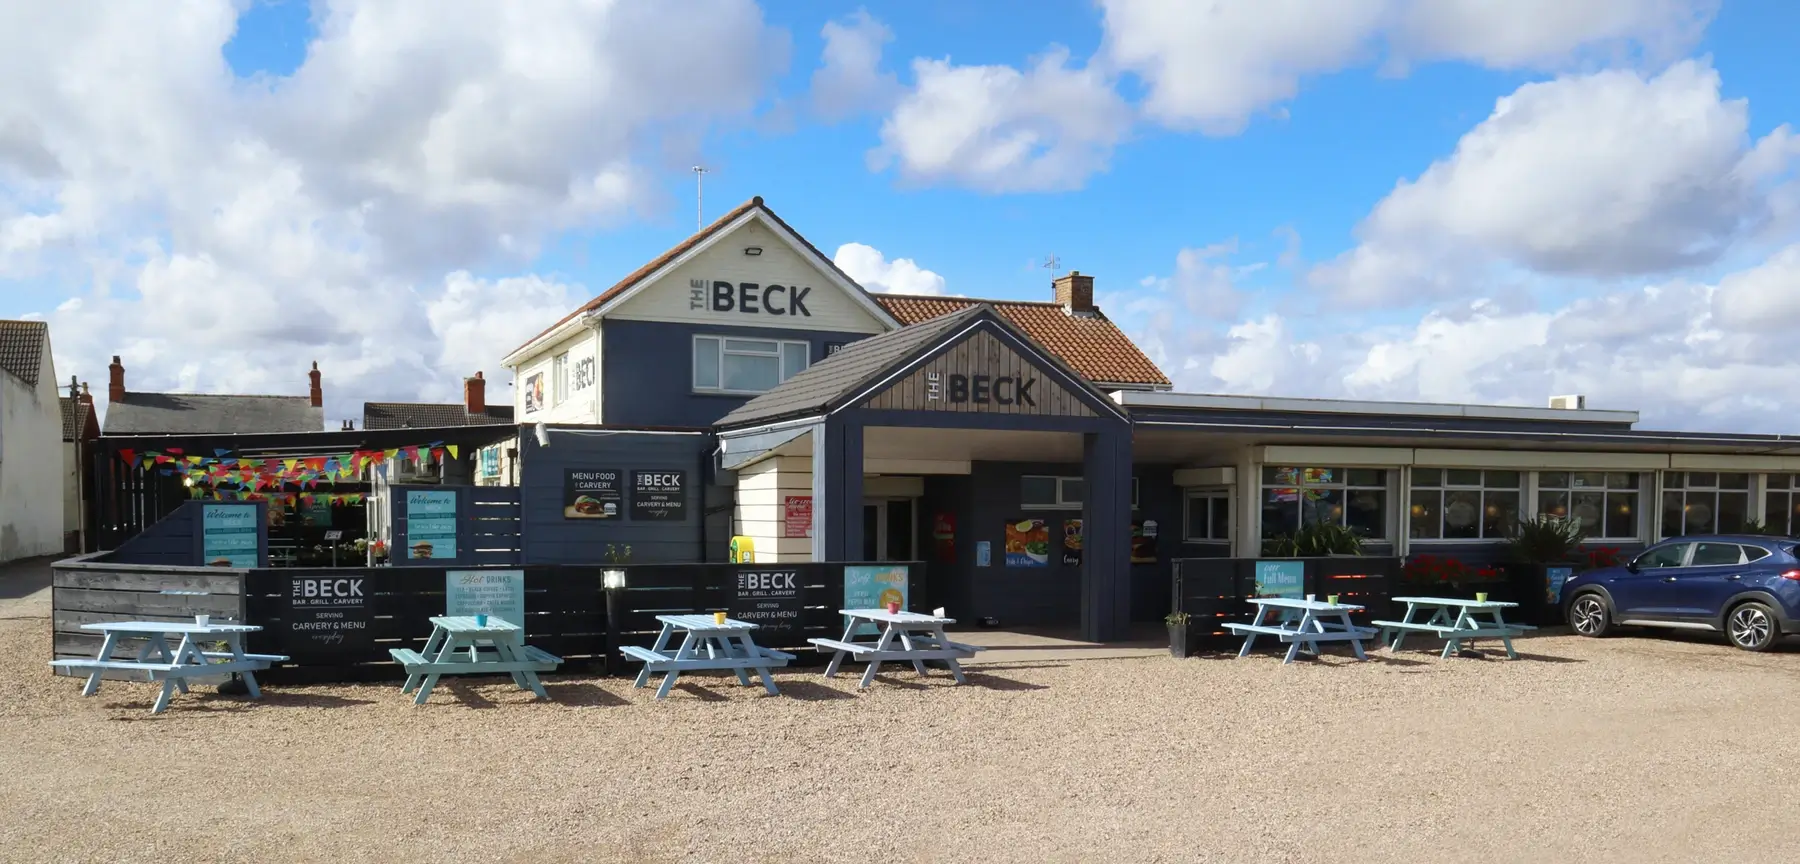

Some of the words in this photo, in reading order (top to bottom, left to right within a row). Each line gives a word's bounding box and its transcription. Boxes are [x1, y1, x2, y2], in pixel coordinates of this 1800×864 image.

[690, 279, 703, 310] THE
[713, 281, 811, 317] BECK
[928, 372, 940, 402] THE
[949, 374, 1036, 407] BECK
[572, 472, 594, 480] MENU
[595, 472, 616, 480] FOOD
[644, 474, 681, 486] BECK
[579, 481, 612, 489] CARVERY
[410, 495, 442, 505] Welcome
[443, 496, 451, 505] to
[206, 509, 242, 519] Welcome
[243, 511, 251, 519] to
[459, 575, 485, 585] Hot
[486, 575, 512, 584] DRINKS
[747, 572, 796, 590] BECK
[1263, 572, 1277, 585] Full
[292, 580, 301, 597] THE
[304, 579, 364, 597] BECK
[737, 611, 770, 619] CARVERY
[776, 610, 798, 618] MENU
[292, 622, 332, 630] CARVERY
[333, 621, 339, 629] &
[340, 621, 366, 629] MENU
